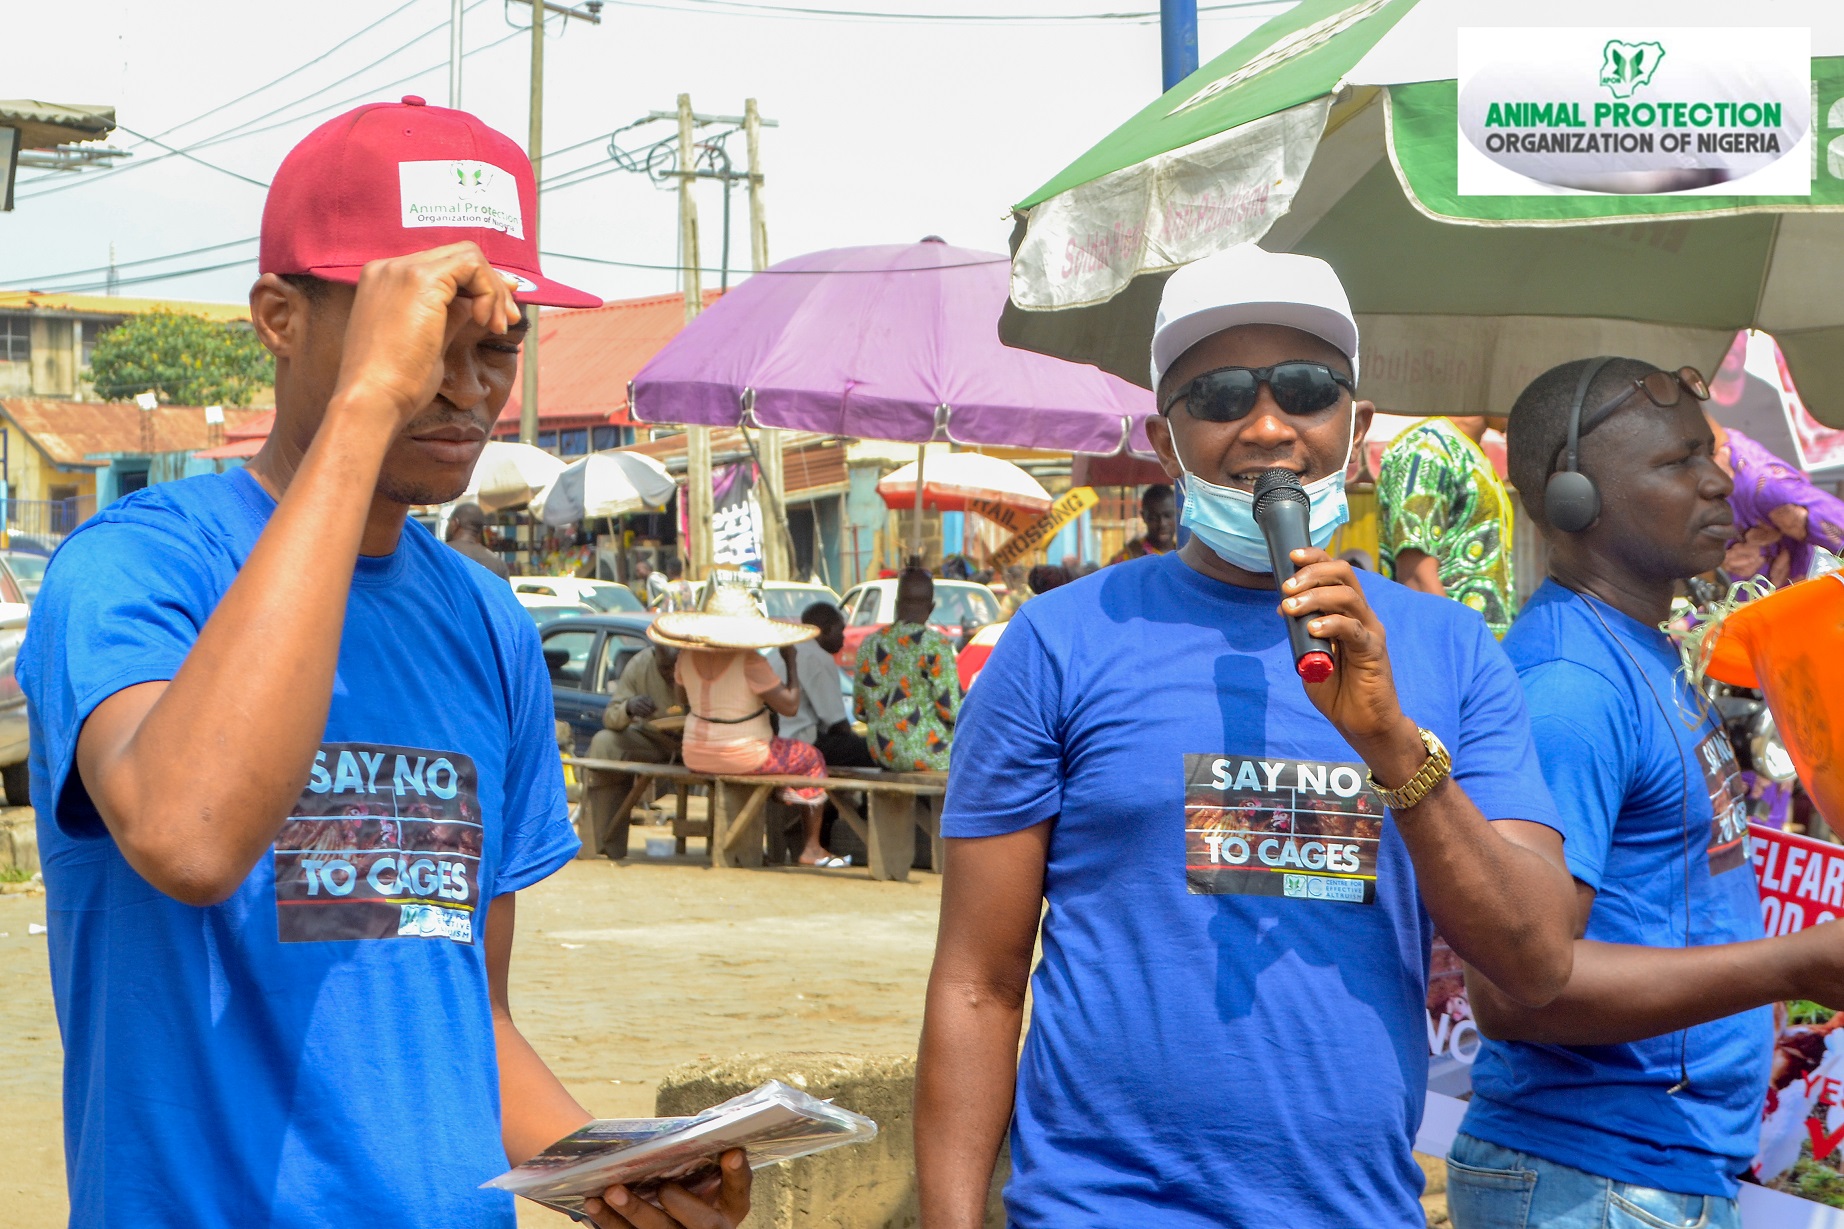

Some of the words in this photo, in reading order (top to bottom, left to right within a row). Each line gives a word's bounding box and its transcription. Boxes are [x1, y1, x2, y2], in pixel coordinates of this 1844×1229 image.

[409, 203, 460, 214] Animal
[417, 214, 482, 223] Organization
[993, 493, 1084, 564] CROSSING
[309, 750, 385, 794] SAY
[393, 754, 458, 800] NO
[1211, 758, 1285, 792] SAY
[1297, 764, 1362, 798] NO
[1204, 836, 1250, 865] TO
[1257, 838, 1360, 873] CAGES
[1750, 836, 1844, 909] ELFAR
[301, 859, 357, 896] TO
[366, 857, 469, 901] CAGES
[1326, 879, 1348, 887] CENTRE
[1801, 1069, 1844, 1109] YE
